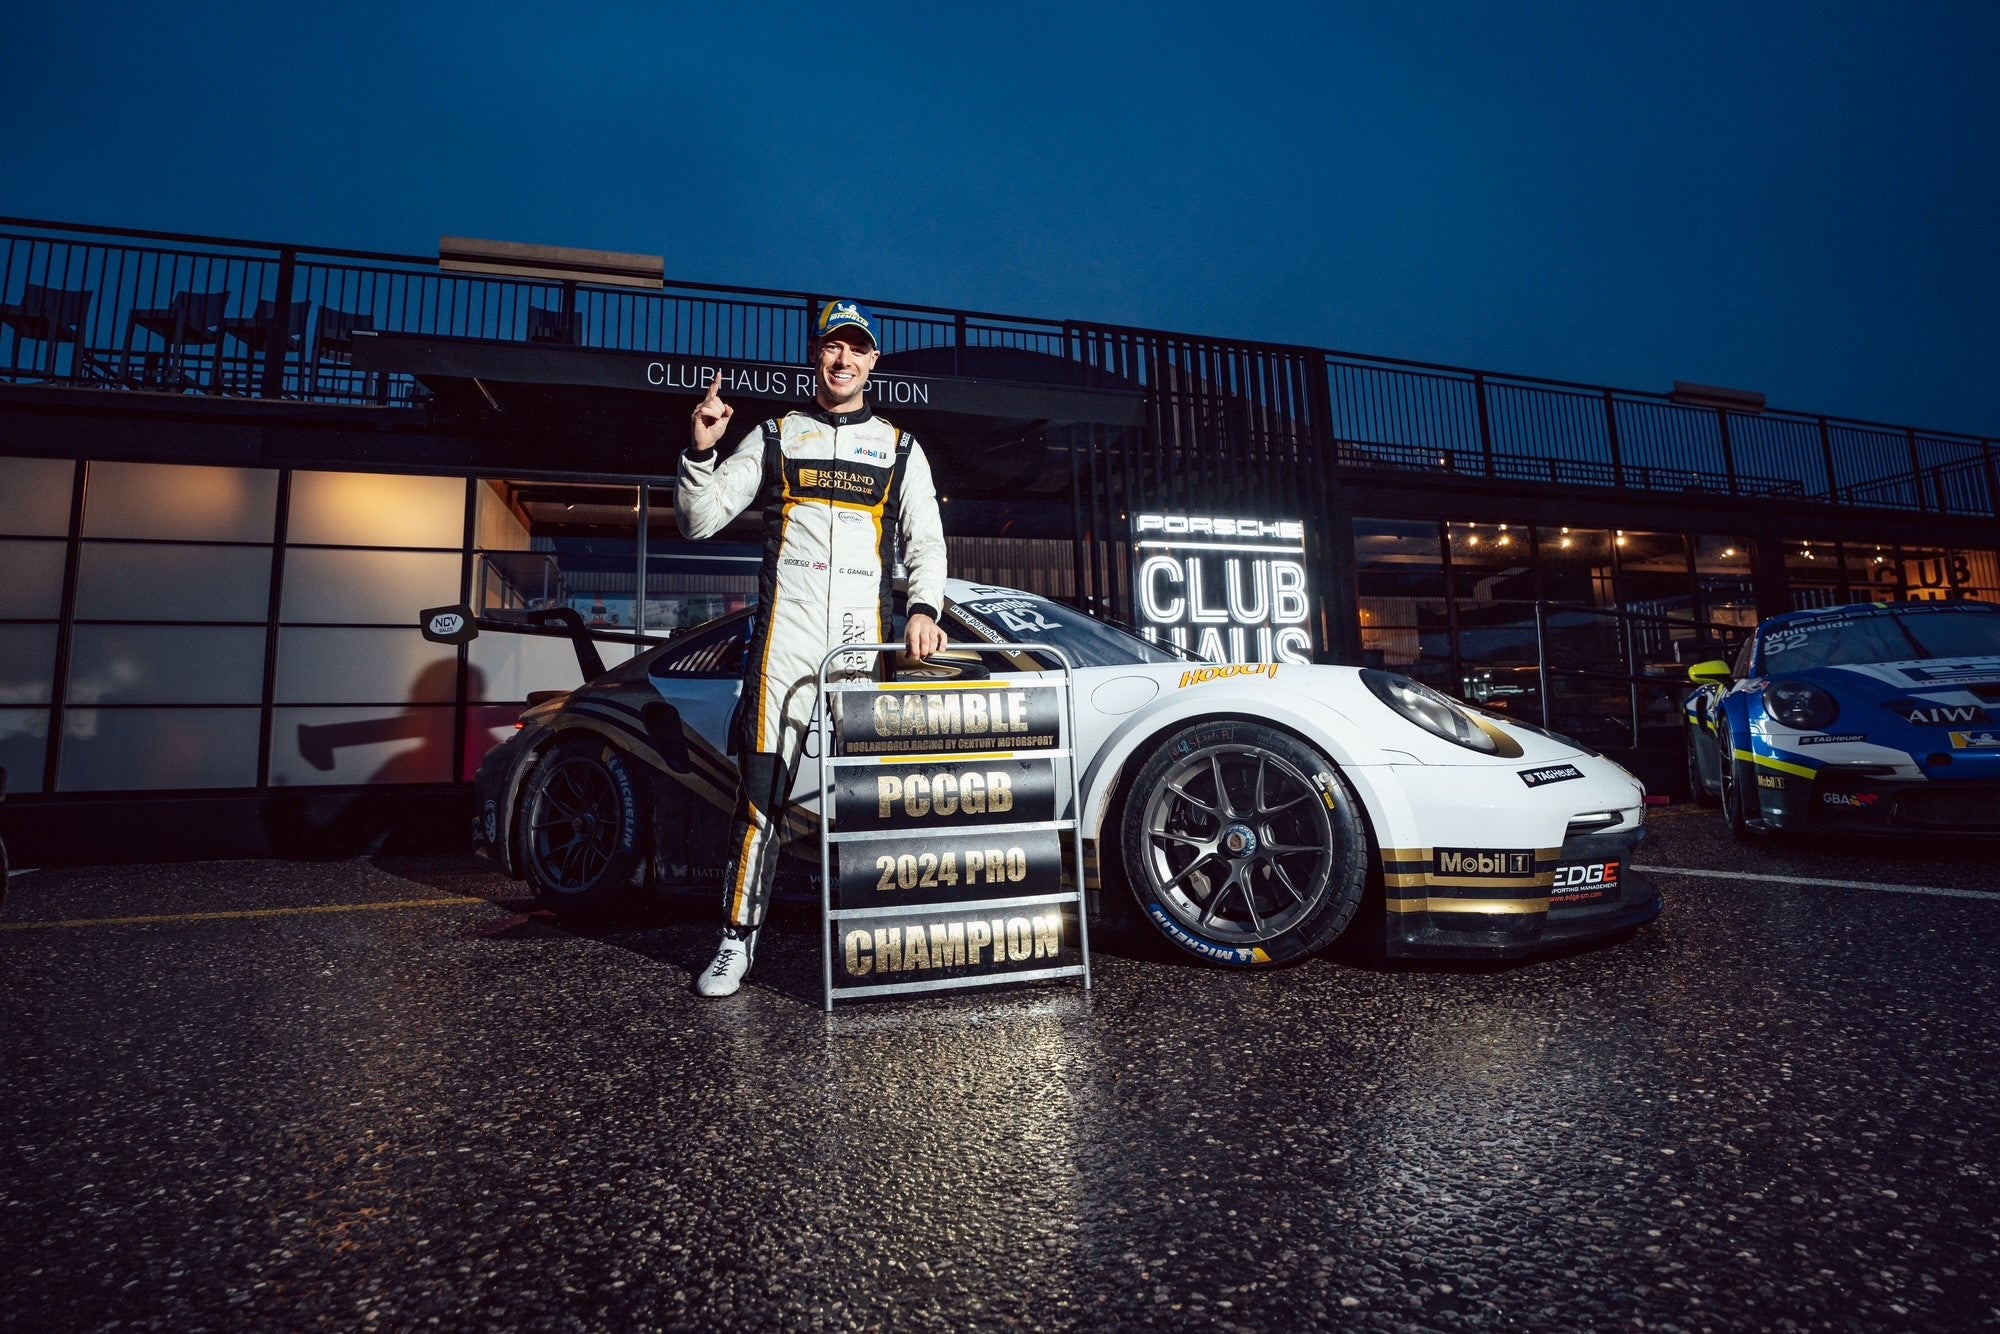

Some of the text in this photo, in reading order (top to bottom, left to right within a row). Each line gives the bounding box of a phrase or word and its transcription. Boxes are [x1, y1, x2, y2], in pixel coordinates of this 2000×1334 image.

[647, 362, 928, 404] CLUBHAUS RPTION
[854, 447, 878, 458] Mobil
[818, 471, 874, 486] ROSLAND
[1137, 515, 1303, 539] PORSCHE
[847, 569, 874, 577] GAMBLE
[1875, 556, 1971, 588] CUB
[1139, 556, 1309, 624] CLUB
[435, 616, 458, 628] NCV
[951, 603, 1021, 657] www.porsche.ck
[997, 608, 1063, 632] 42
[1765, 621, 1854, 641] Whiteside
[1142, 627, 1311, 664] AUS
[1764, 633, 1809, 655] 52
[1178, 663, 1279, 688] HOOCH
[873, 692, 1029, 737] GAMBLE
[1909, 707, 1975, 722] AIW
[945, 739, 956, 749] BY
[957, 737, 996, 748] CENTURY
[997, 735, 1054, 747] MOTORSPORT
[877, 771, 1014, 819] PCCGB
[1823, 793, 1850, 805] GBA
[876, 852, 959, 891] 2024
[966, 847, 1027, 886] PRO
[1440, 852, 1506, 873] Mobil
[1553, 863, 1619, 887] EDGE
[1580, 882, 1618, 892] MANAGEMENT
[845, 915, 1063, 977] CHAMPION
[1152, 910, 1234, 961] MICHELIN
